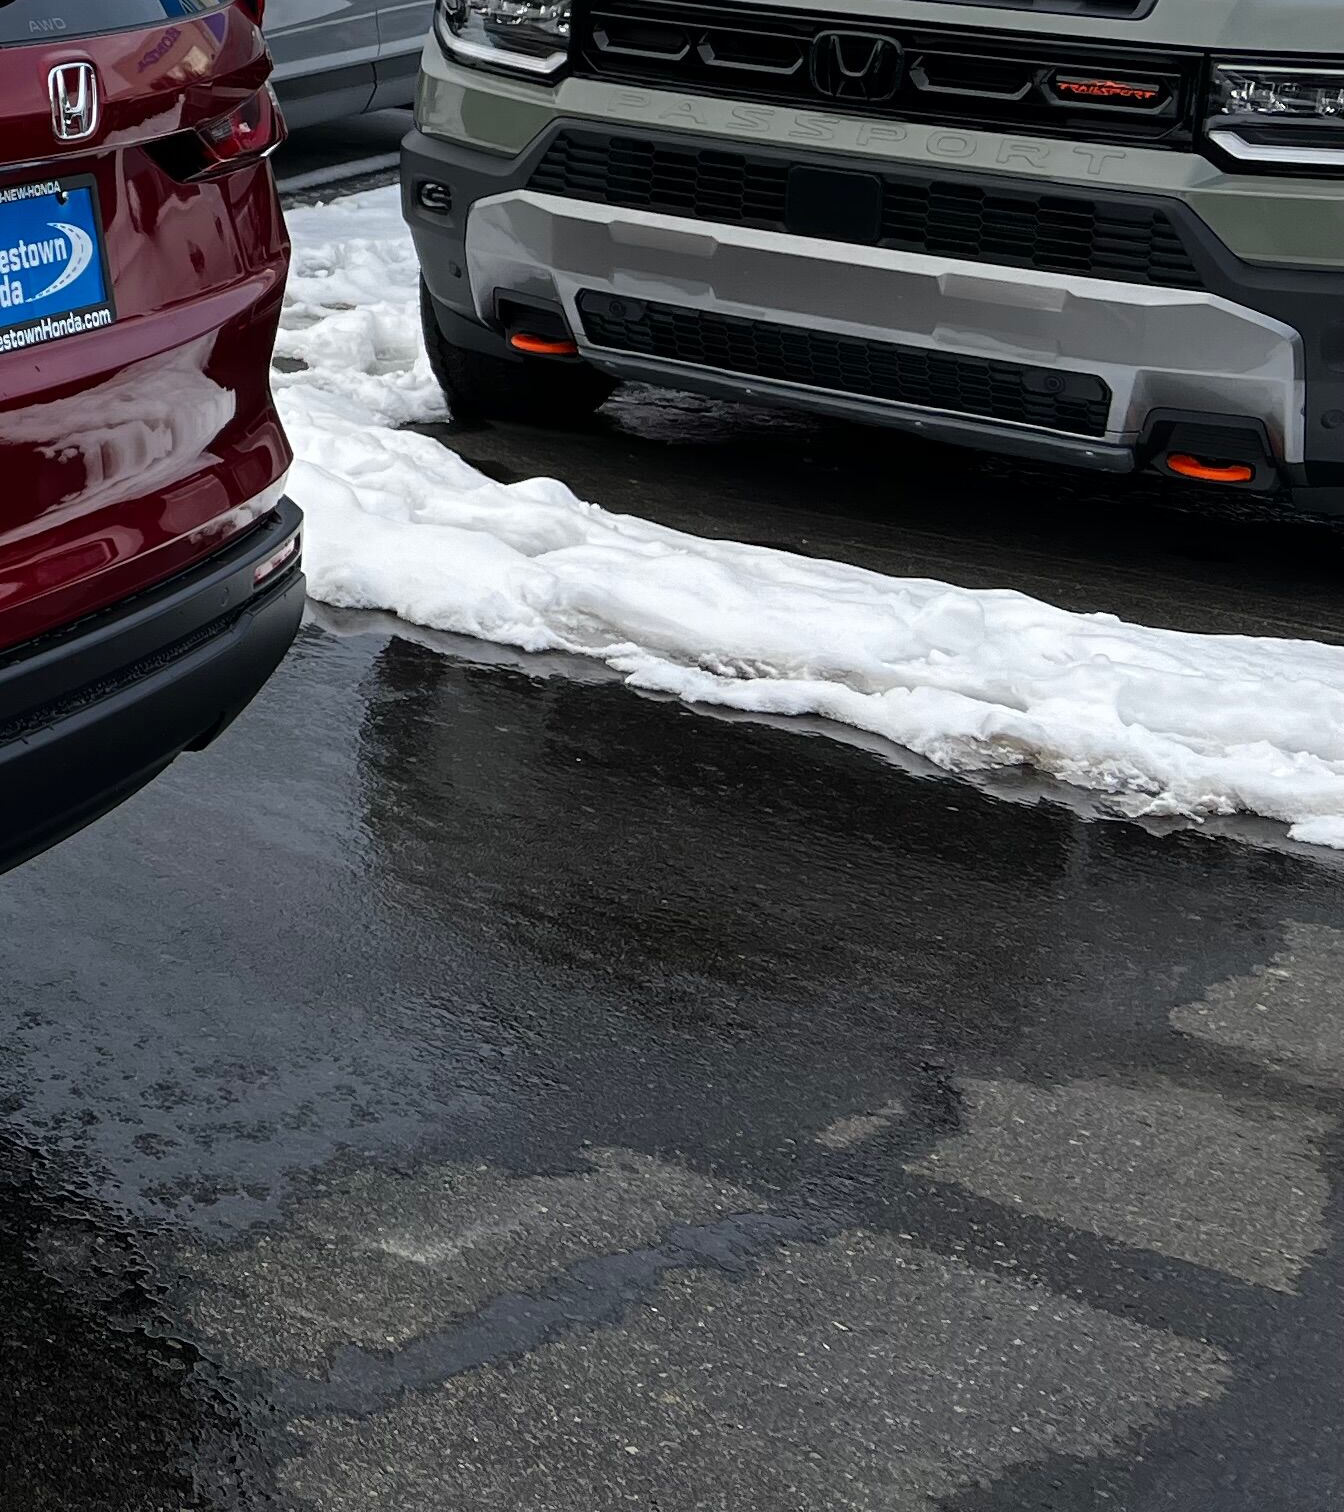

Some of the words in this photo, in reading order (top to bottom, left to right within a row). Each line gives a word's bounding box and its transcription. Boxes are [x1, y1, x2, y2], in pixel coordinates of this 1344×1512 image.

[27, 17, 67, 34] AWD
[1057, 82, 1156, 99] TRAILSPORT
[605, 90, 1127, 176] PASSPORT
